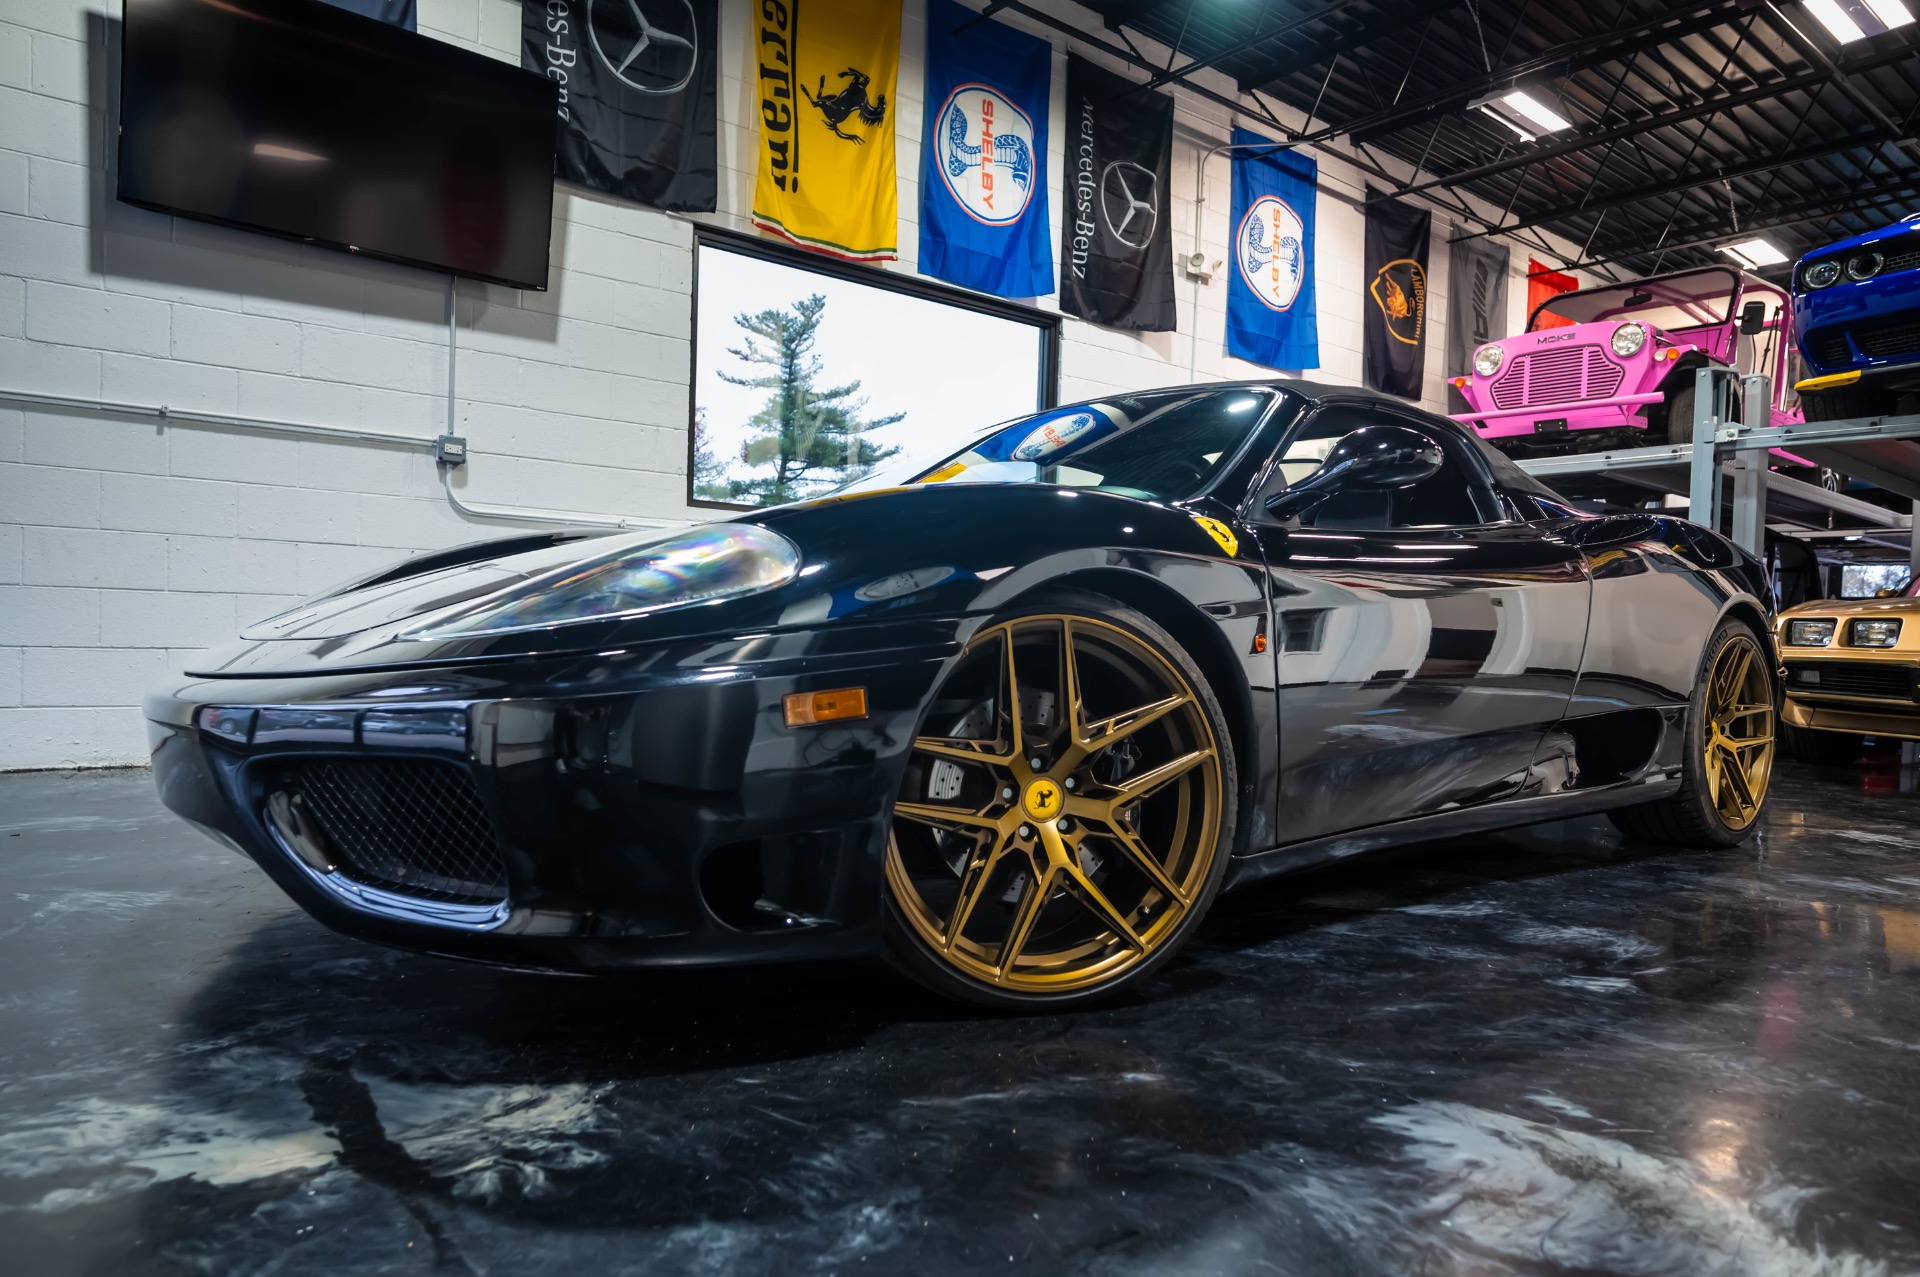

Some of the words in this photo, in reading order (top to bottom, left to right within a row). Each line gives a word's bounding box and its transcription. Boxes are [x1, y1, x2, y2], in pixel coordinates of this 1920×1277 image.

[760, 0, 799, 194] errari
[981, 98, 994, 211] SHELBY
[1073, 96, 1096, 280] Mercedes-Benz
[1272, 208, 1281, 298] SHELBY
[1410, 268, 1424, 339] LAMBORGHINI
[1537, 333, 1576, 345] MOKE
